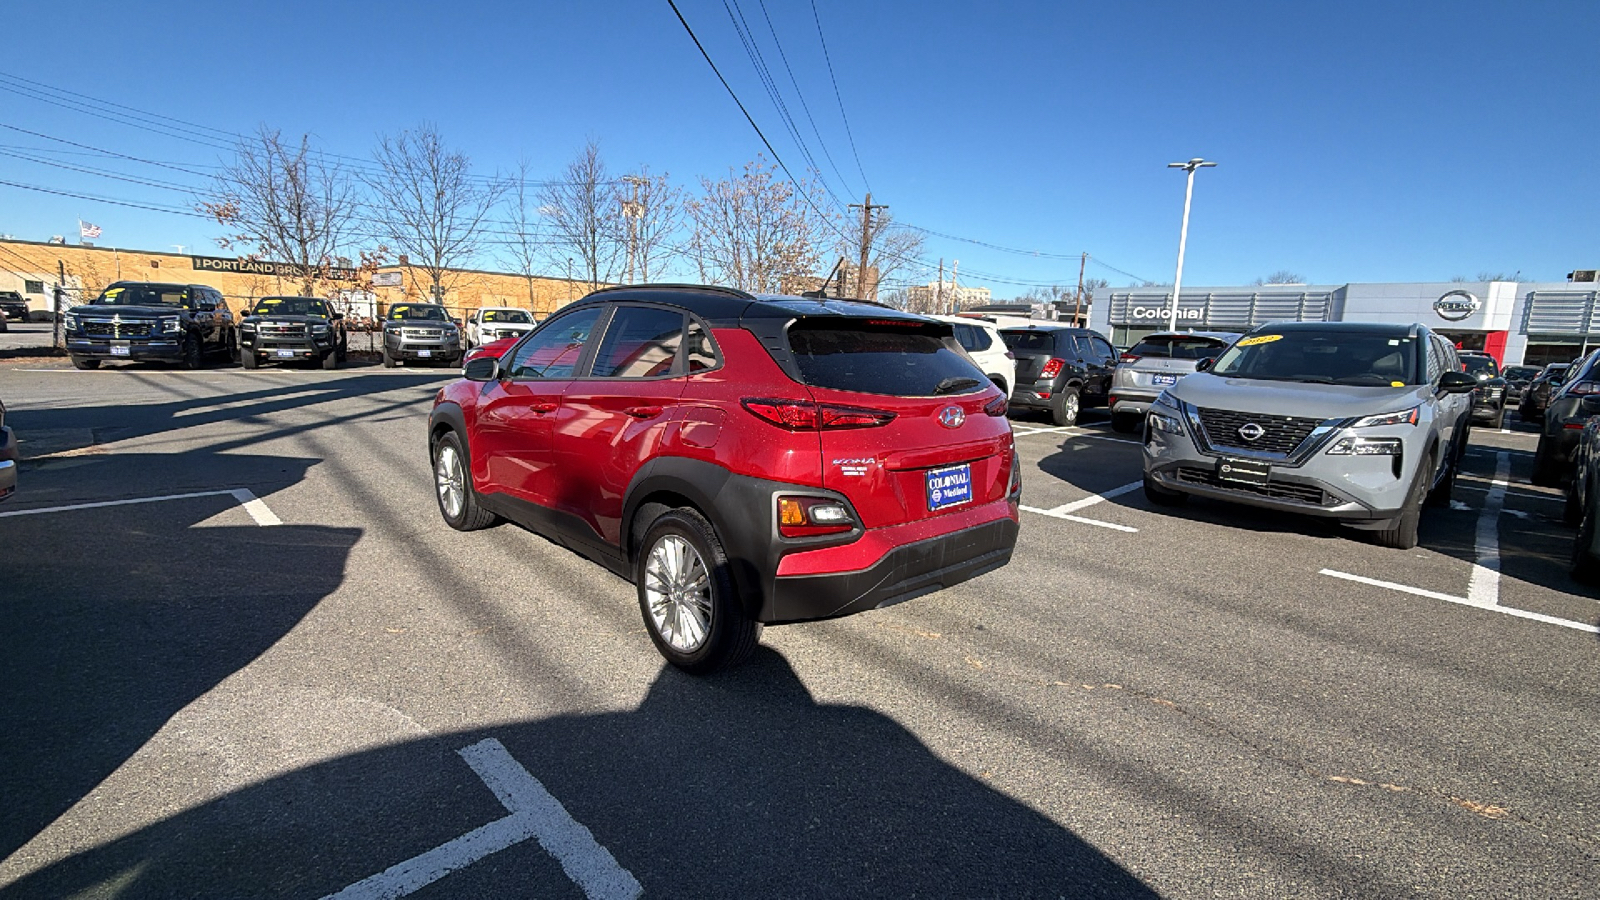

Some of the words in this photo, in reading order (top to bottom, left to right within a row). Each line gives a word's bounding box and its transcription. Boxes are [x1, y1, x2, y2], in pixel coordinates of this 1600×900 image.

[203, 259, 274, 273] PORTLAND
[1133, 306, 1204, 319] Colonial
[929, 472, 969, 490] COLONIAL
